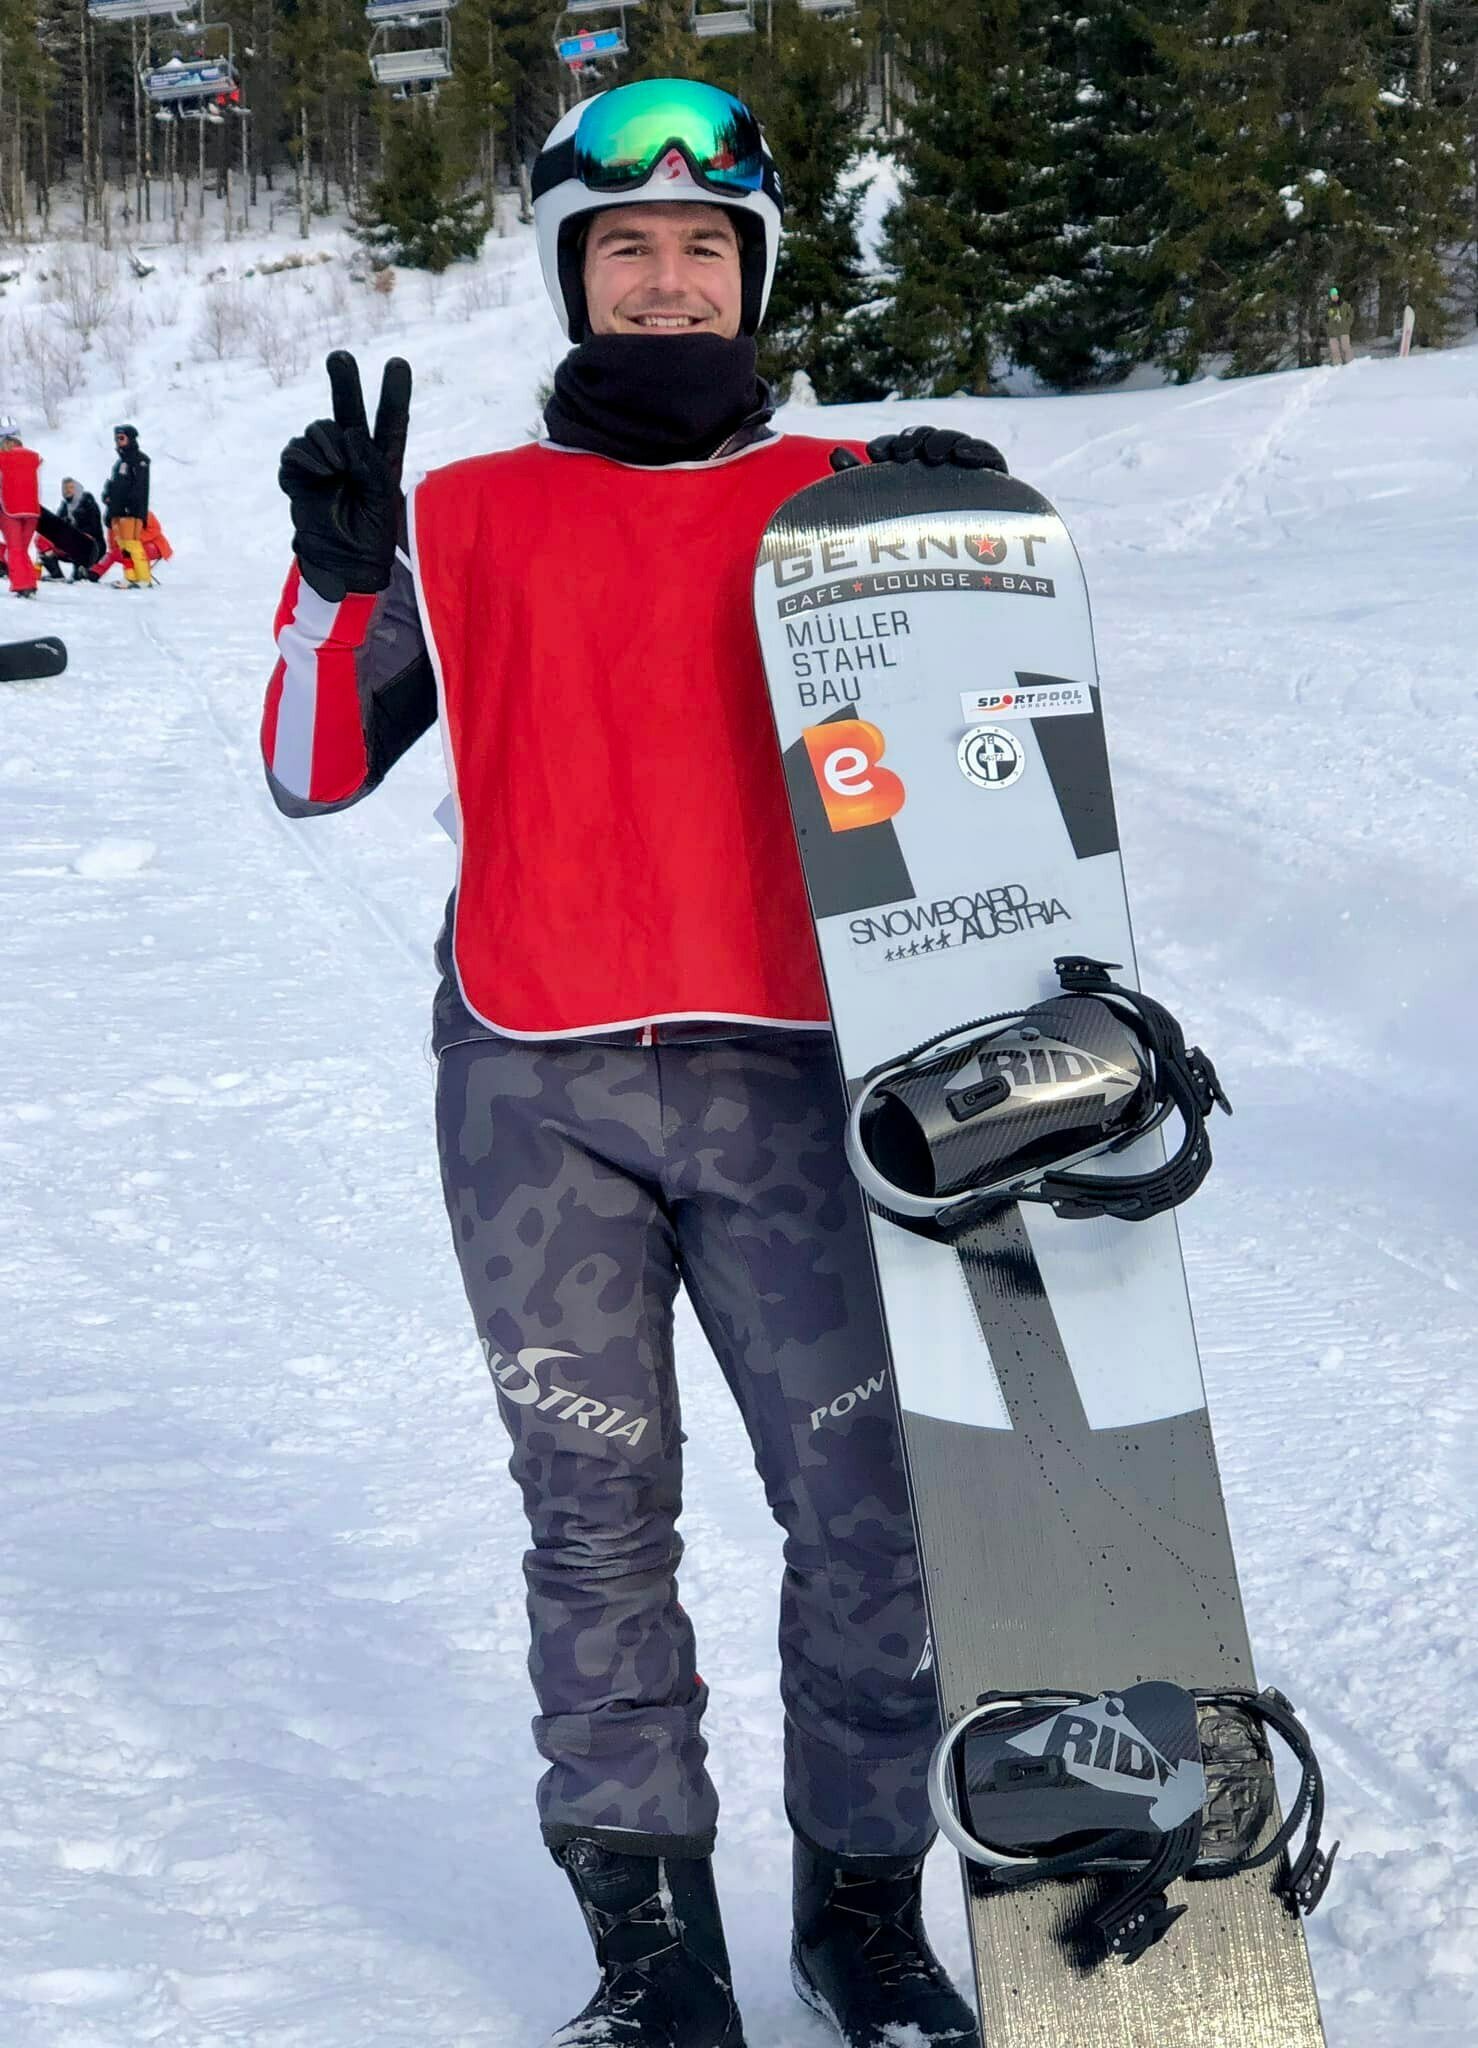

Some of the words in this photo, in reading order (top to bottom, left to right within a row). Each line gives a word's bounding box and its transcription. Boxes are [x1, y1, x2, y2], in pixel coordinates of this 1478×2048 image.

[772, 533, 1047, 588] GERNOT
[784, 584, 843, 614] CAFE
[873, 572, 972, 592] LOUNGE
[1002, 576, 1049, 594] BAR
[785, 609, 911, 648] MÜLLER
[792, 642, 897, 678] STAHL
[798, 676, 862, 708] BAU
[977, 689, 1083, 707] SPORTPOOL
[849, 884, 1028, 945] SNOWBOARD
[961, 898, 1072, 945] AUSTRIA
